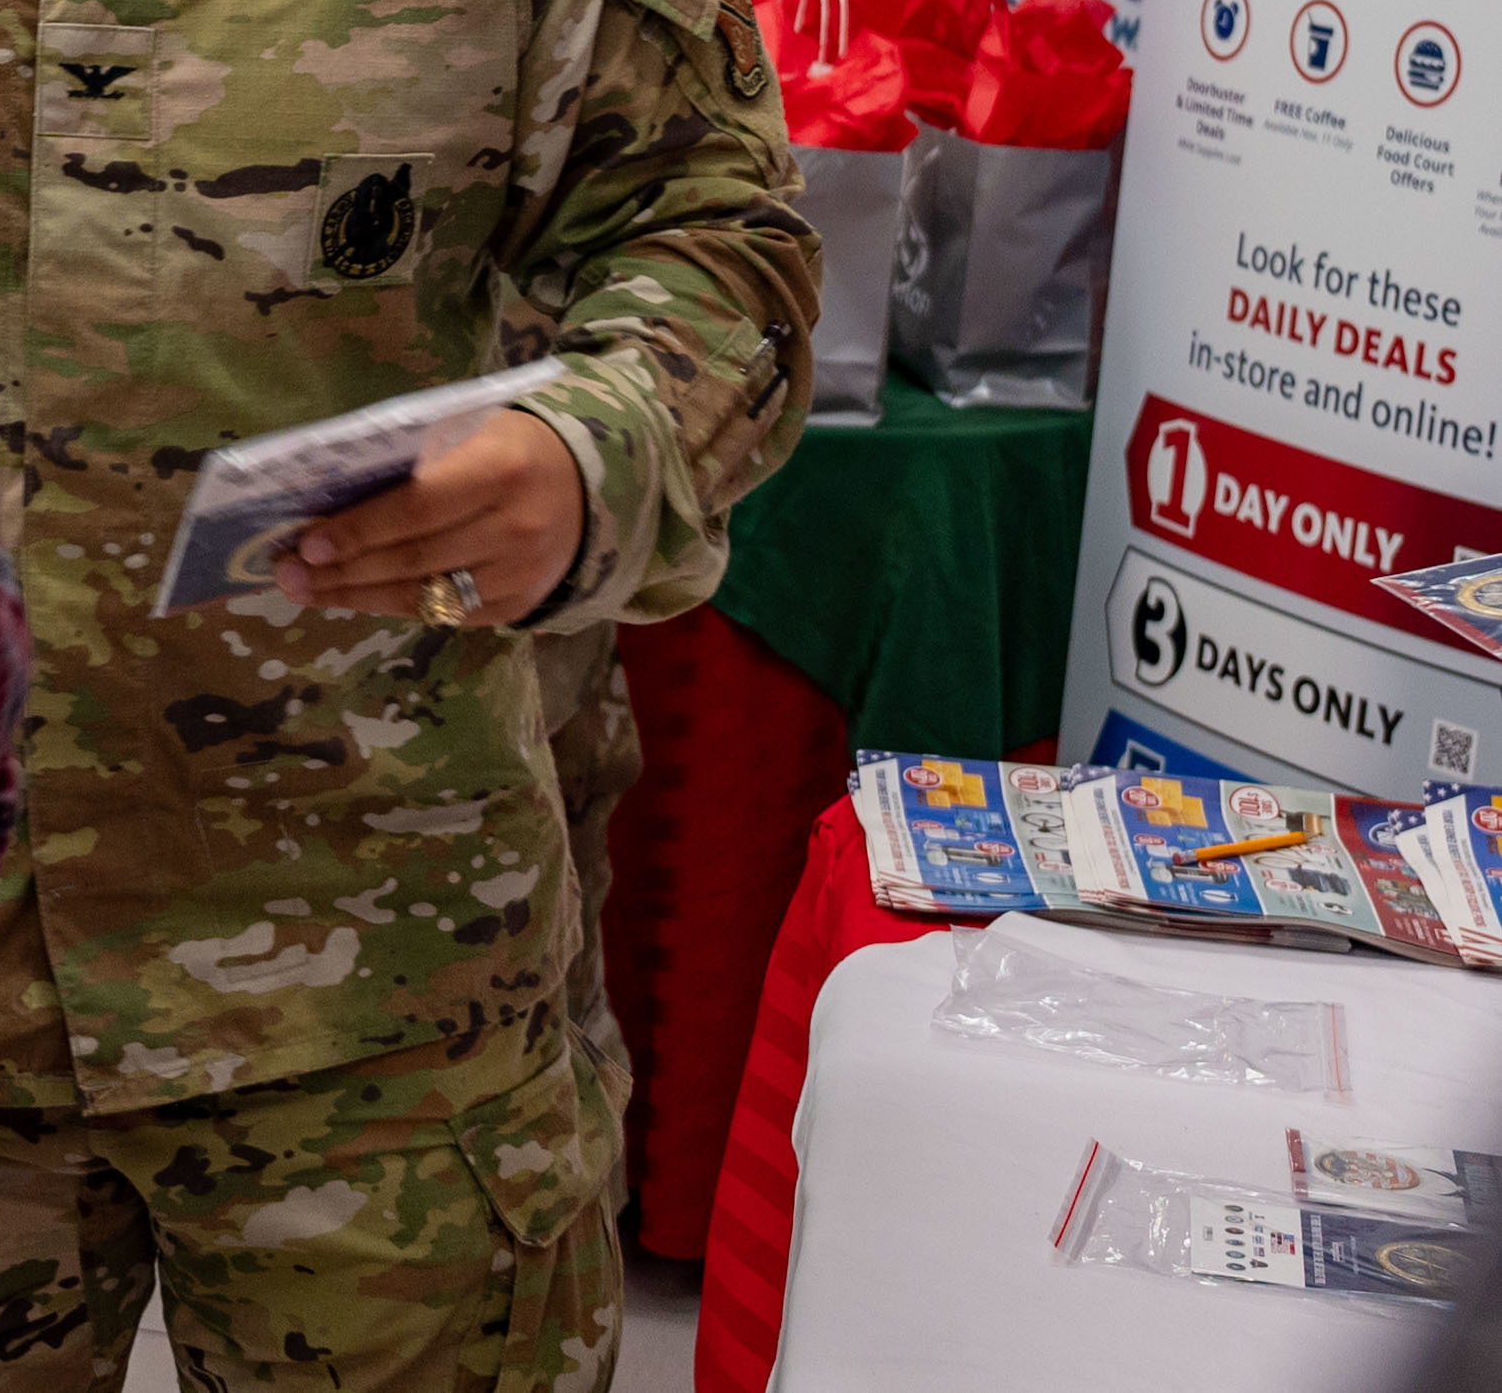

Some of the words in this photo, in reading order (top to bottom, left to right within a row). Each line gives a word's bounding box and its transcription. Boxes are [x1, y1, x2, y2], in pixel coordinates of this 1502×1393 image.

[1186, 77, 1245, 104] Doorbuster
[1186, 95, 1224, 119] Limited
[1226, 108, 1253, 127] Time
[1273, 99, 1302, 119] FREE
[1305, 106, 1346, 130] Coffee
[1196, 120, 1226, 140] Deals
[1386, 125, 1450, 153] Delicious
[1376, 144, 1410, 166] Food
[1413, 153, 1454, 177] Court
[1390, 169, 1434, 193] Offers
[1236, 231, 1304, 285] Look
[1314, 250, 1359, 298] for
[1368, 269, 1462, 328] these
[1226, 286, 1327, 348] DAILY
[1333, 319, 1457, 386] DEALS
[1188, 330, 1296, 400] in-store
[1303, 377, 1363, 422] and
[1371, 398, 1497, 459] online!
[1152, 418, 1196, 538] 1
[1214, 472, 1289, 534] DAY
[1292, 502, 1405, 572] ONLY
[1135, 577, 1184, 687] 3
[1197, 635, 1284, 702] DAYS
[1293, 676, 1405, 746] ONLY
